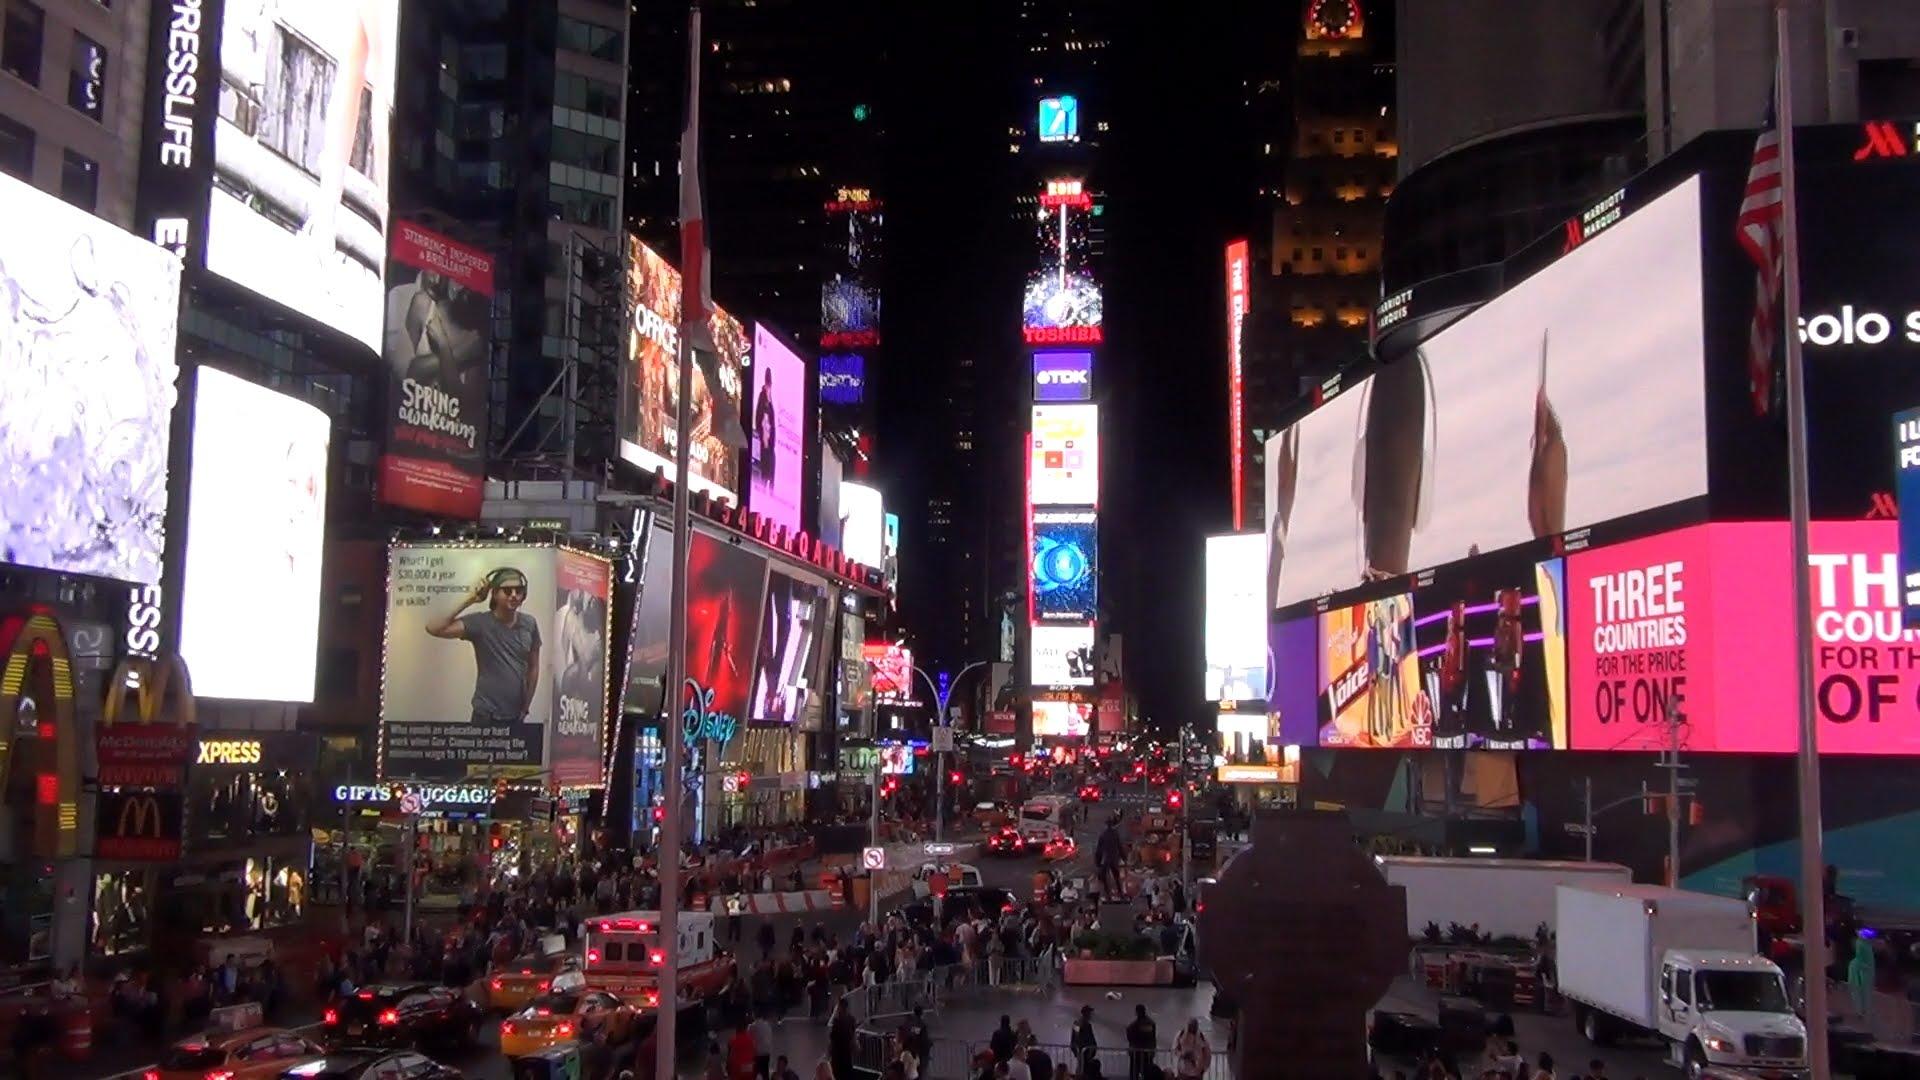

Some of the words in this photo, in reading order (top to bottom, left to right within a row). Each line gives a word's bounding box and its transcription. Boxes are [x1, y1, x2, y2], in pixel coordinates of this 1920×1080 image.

[635, 303, 677, 355] OFFICE
[1024, 327, 1102, 342] TOSHIBA
[1050, 370, 1087, 384] TDK
[1589, 561, 1685, 623] THREE
[1594, 616, 1687, 654] COUNTRIES
[1816, 610, 1920, 642] COU
[1596, 657, 1618, 677] FOR
[1621, 654, 1644, 675] THE
[1648, 649, 1686, 674] PRICE
[1820, 646, 1878, 669] FOR
[1595, 678, 1626, 724] OF
[1633, 676, 1687, 724] ONE
[1818, 674, 1899, 724] OF
[1411, 727, 1431, 746] NBC
[336, 785, 391, 801] GIFTS
